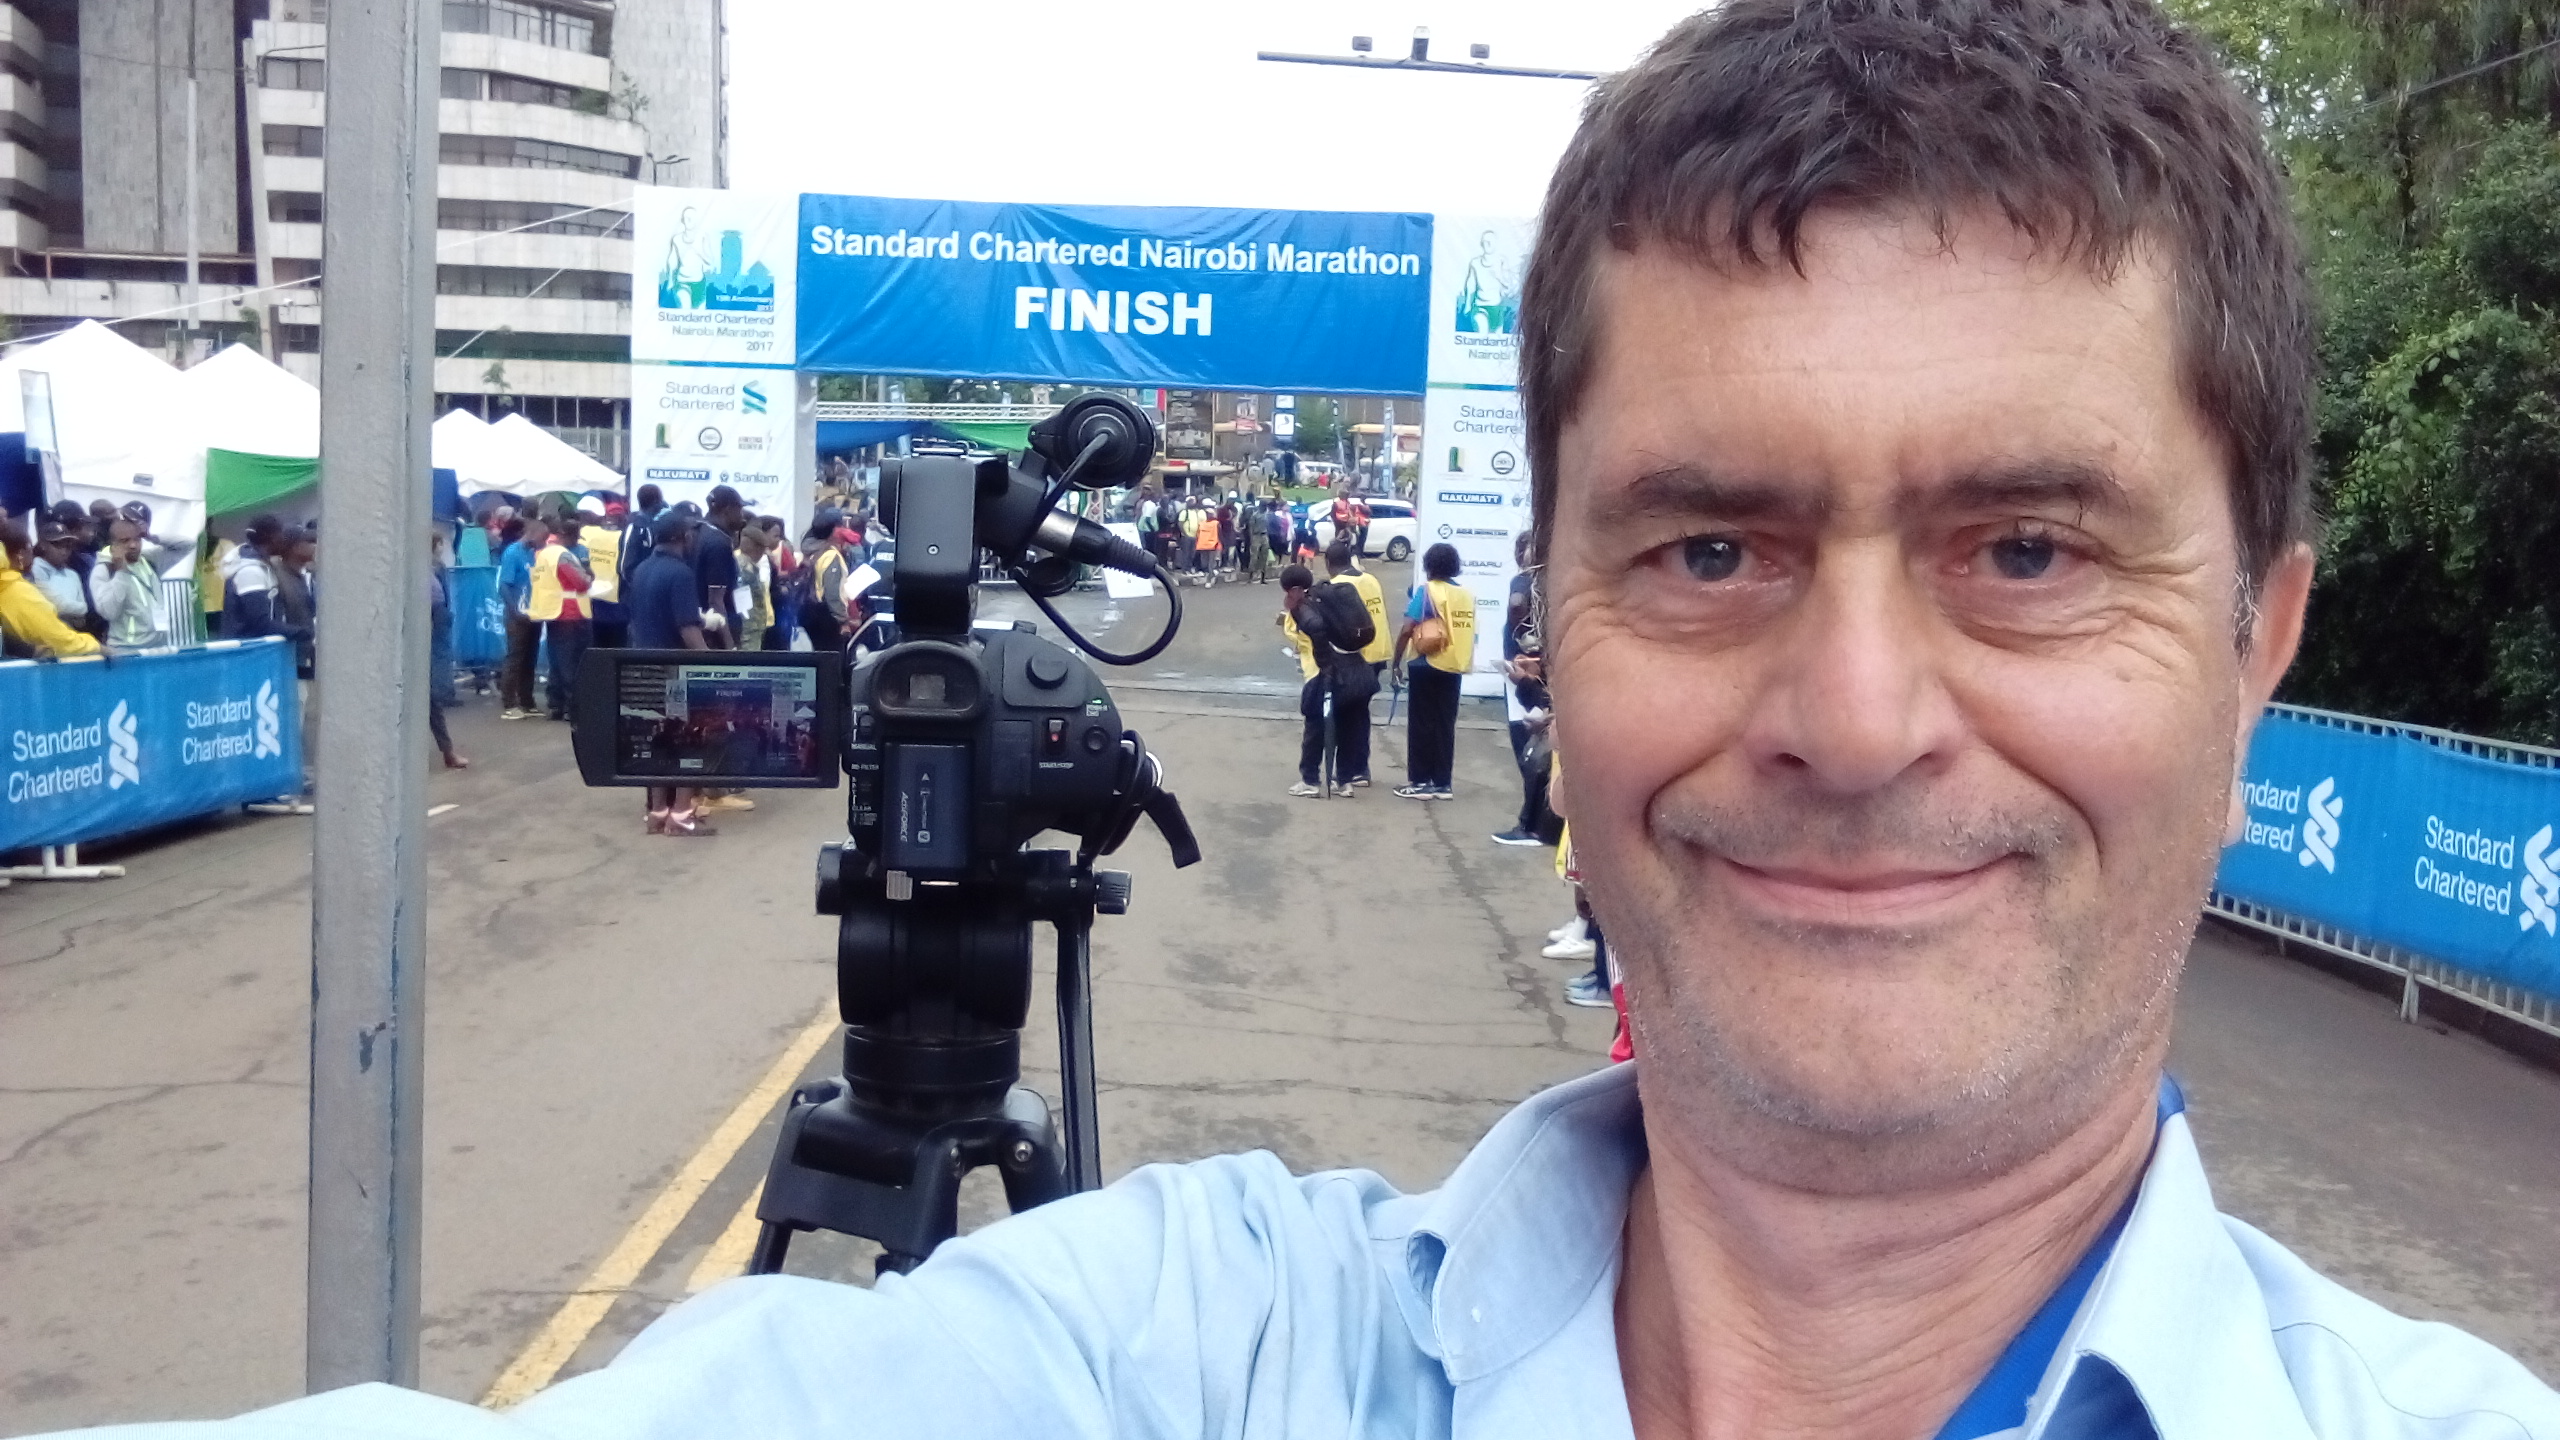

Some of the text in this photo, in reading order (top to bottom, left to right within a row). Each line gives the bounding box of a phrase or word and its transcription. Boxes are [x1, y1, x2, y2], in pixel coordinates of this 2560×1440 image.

[811, 225, 1420, 275] Standard Chartered Nairobi Marathon
[658, 312, 774, 325] Standard Chartered
[1015, 286, 1212, 336] FINISH
[717, 327, 774, 338] Marathon
[746, 341, 774, 351] 2017
[1454, 335, 1509, 347] Standard
[665, 381, 735, 396] Standard
[659, 396, 735, 411] Chartered
[1453, 420, 1519, 434] Chartere
[649, 470, 707, 480] NAKUMATT
[734, 472, 779, 484] Sanlam
[1441, 493, 1500, 504] NAKUMATT
[186, 694, 252, 729] Standard
[13, 718, 102, 762] Standard
[182, 727, 253, 765] Chartered
[8, 755, 103, 803] Chartered
[2244, 815, 2295, 853] tered
[2424, 815, 2515, 870] Standard
[2414, 856, 2512, 915] Chartered
